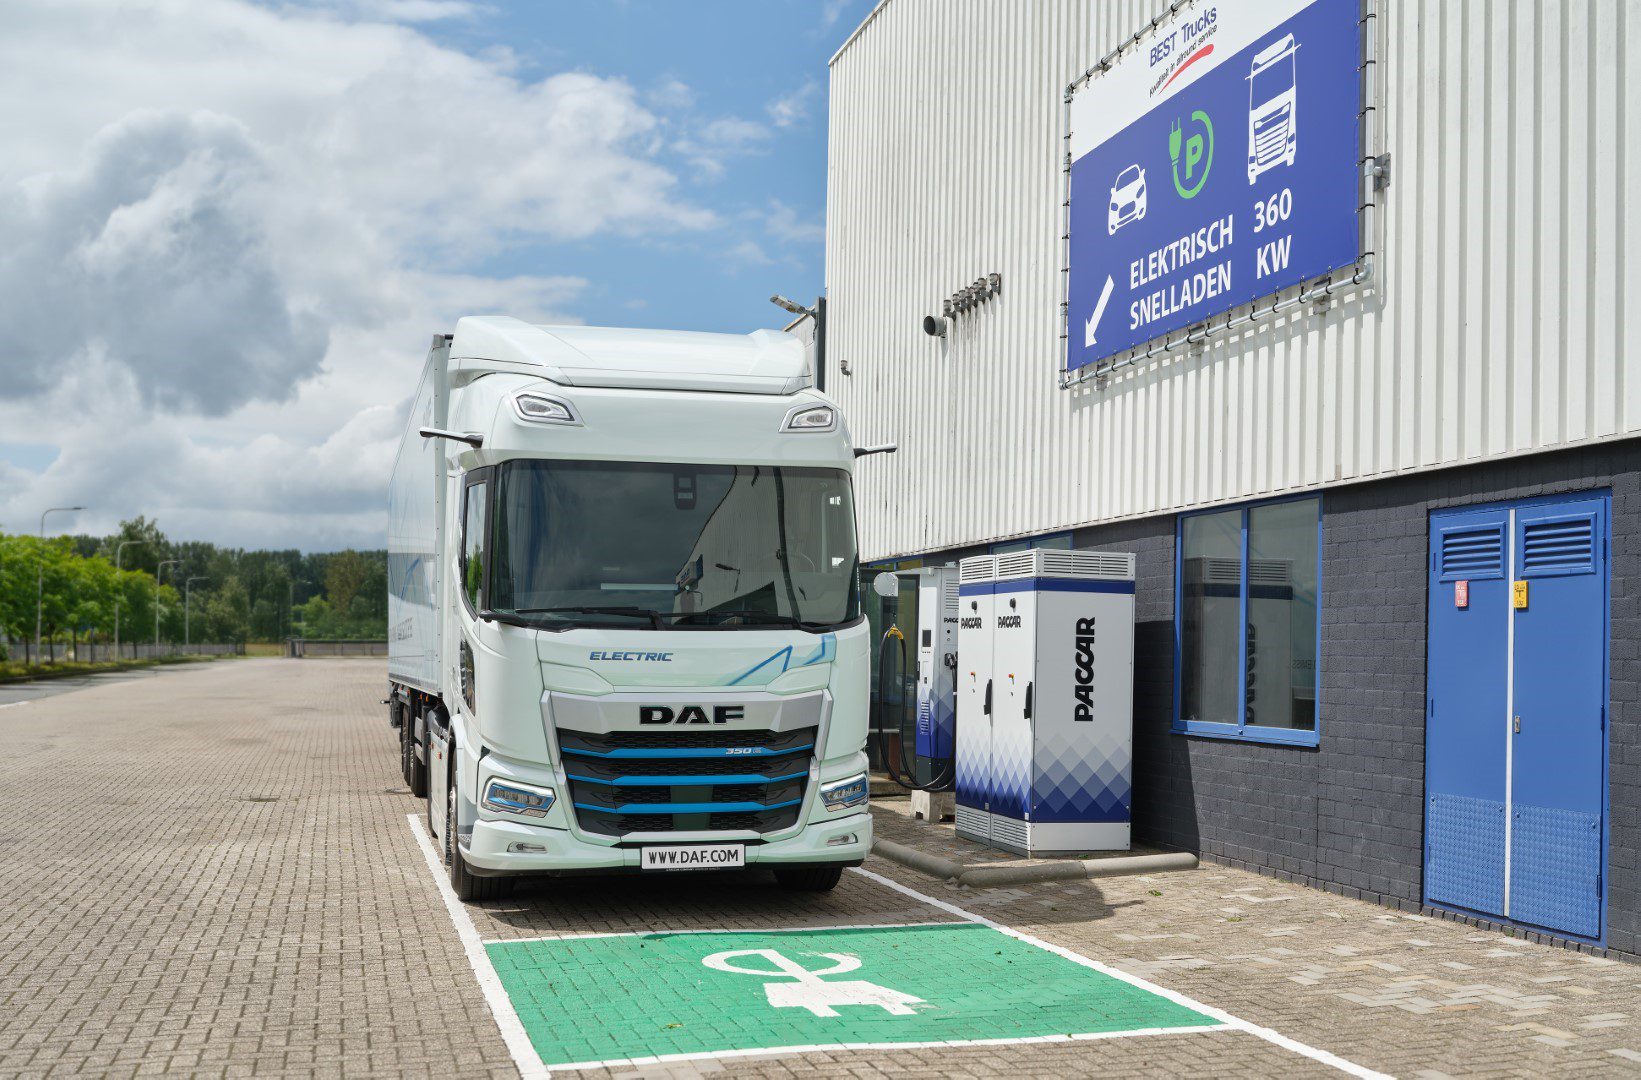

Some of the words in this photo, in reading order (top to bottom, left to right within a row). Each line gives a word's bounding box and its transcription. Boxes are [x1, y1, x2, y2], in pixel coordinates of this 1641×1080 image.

[1150, 31, 1177, 68] BEST
[1181, 7, 1217, 44] Trucks
[1198, 24, 1218, 46] service
[1130, 214, 1233, 290] ELEKTRISCH
[1254, 188, 1292, 233] 360
[1130, 260, 1232, 330] SNELLADEN
[1256, 234, 1292, 279] KW
[961, 617, 982, 629] PACCAR
[997, 616, 1021, 629] PACCAR
[589, 651, 674, 662] ELECTRIC
[1074, 617, 1095, 722] PACCAR
[639, 705, 745, 725] DAF
[648, 849, 739, 864] WWW.DAF.COM
